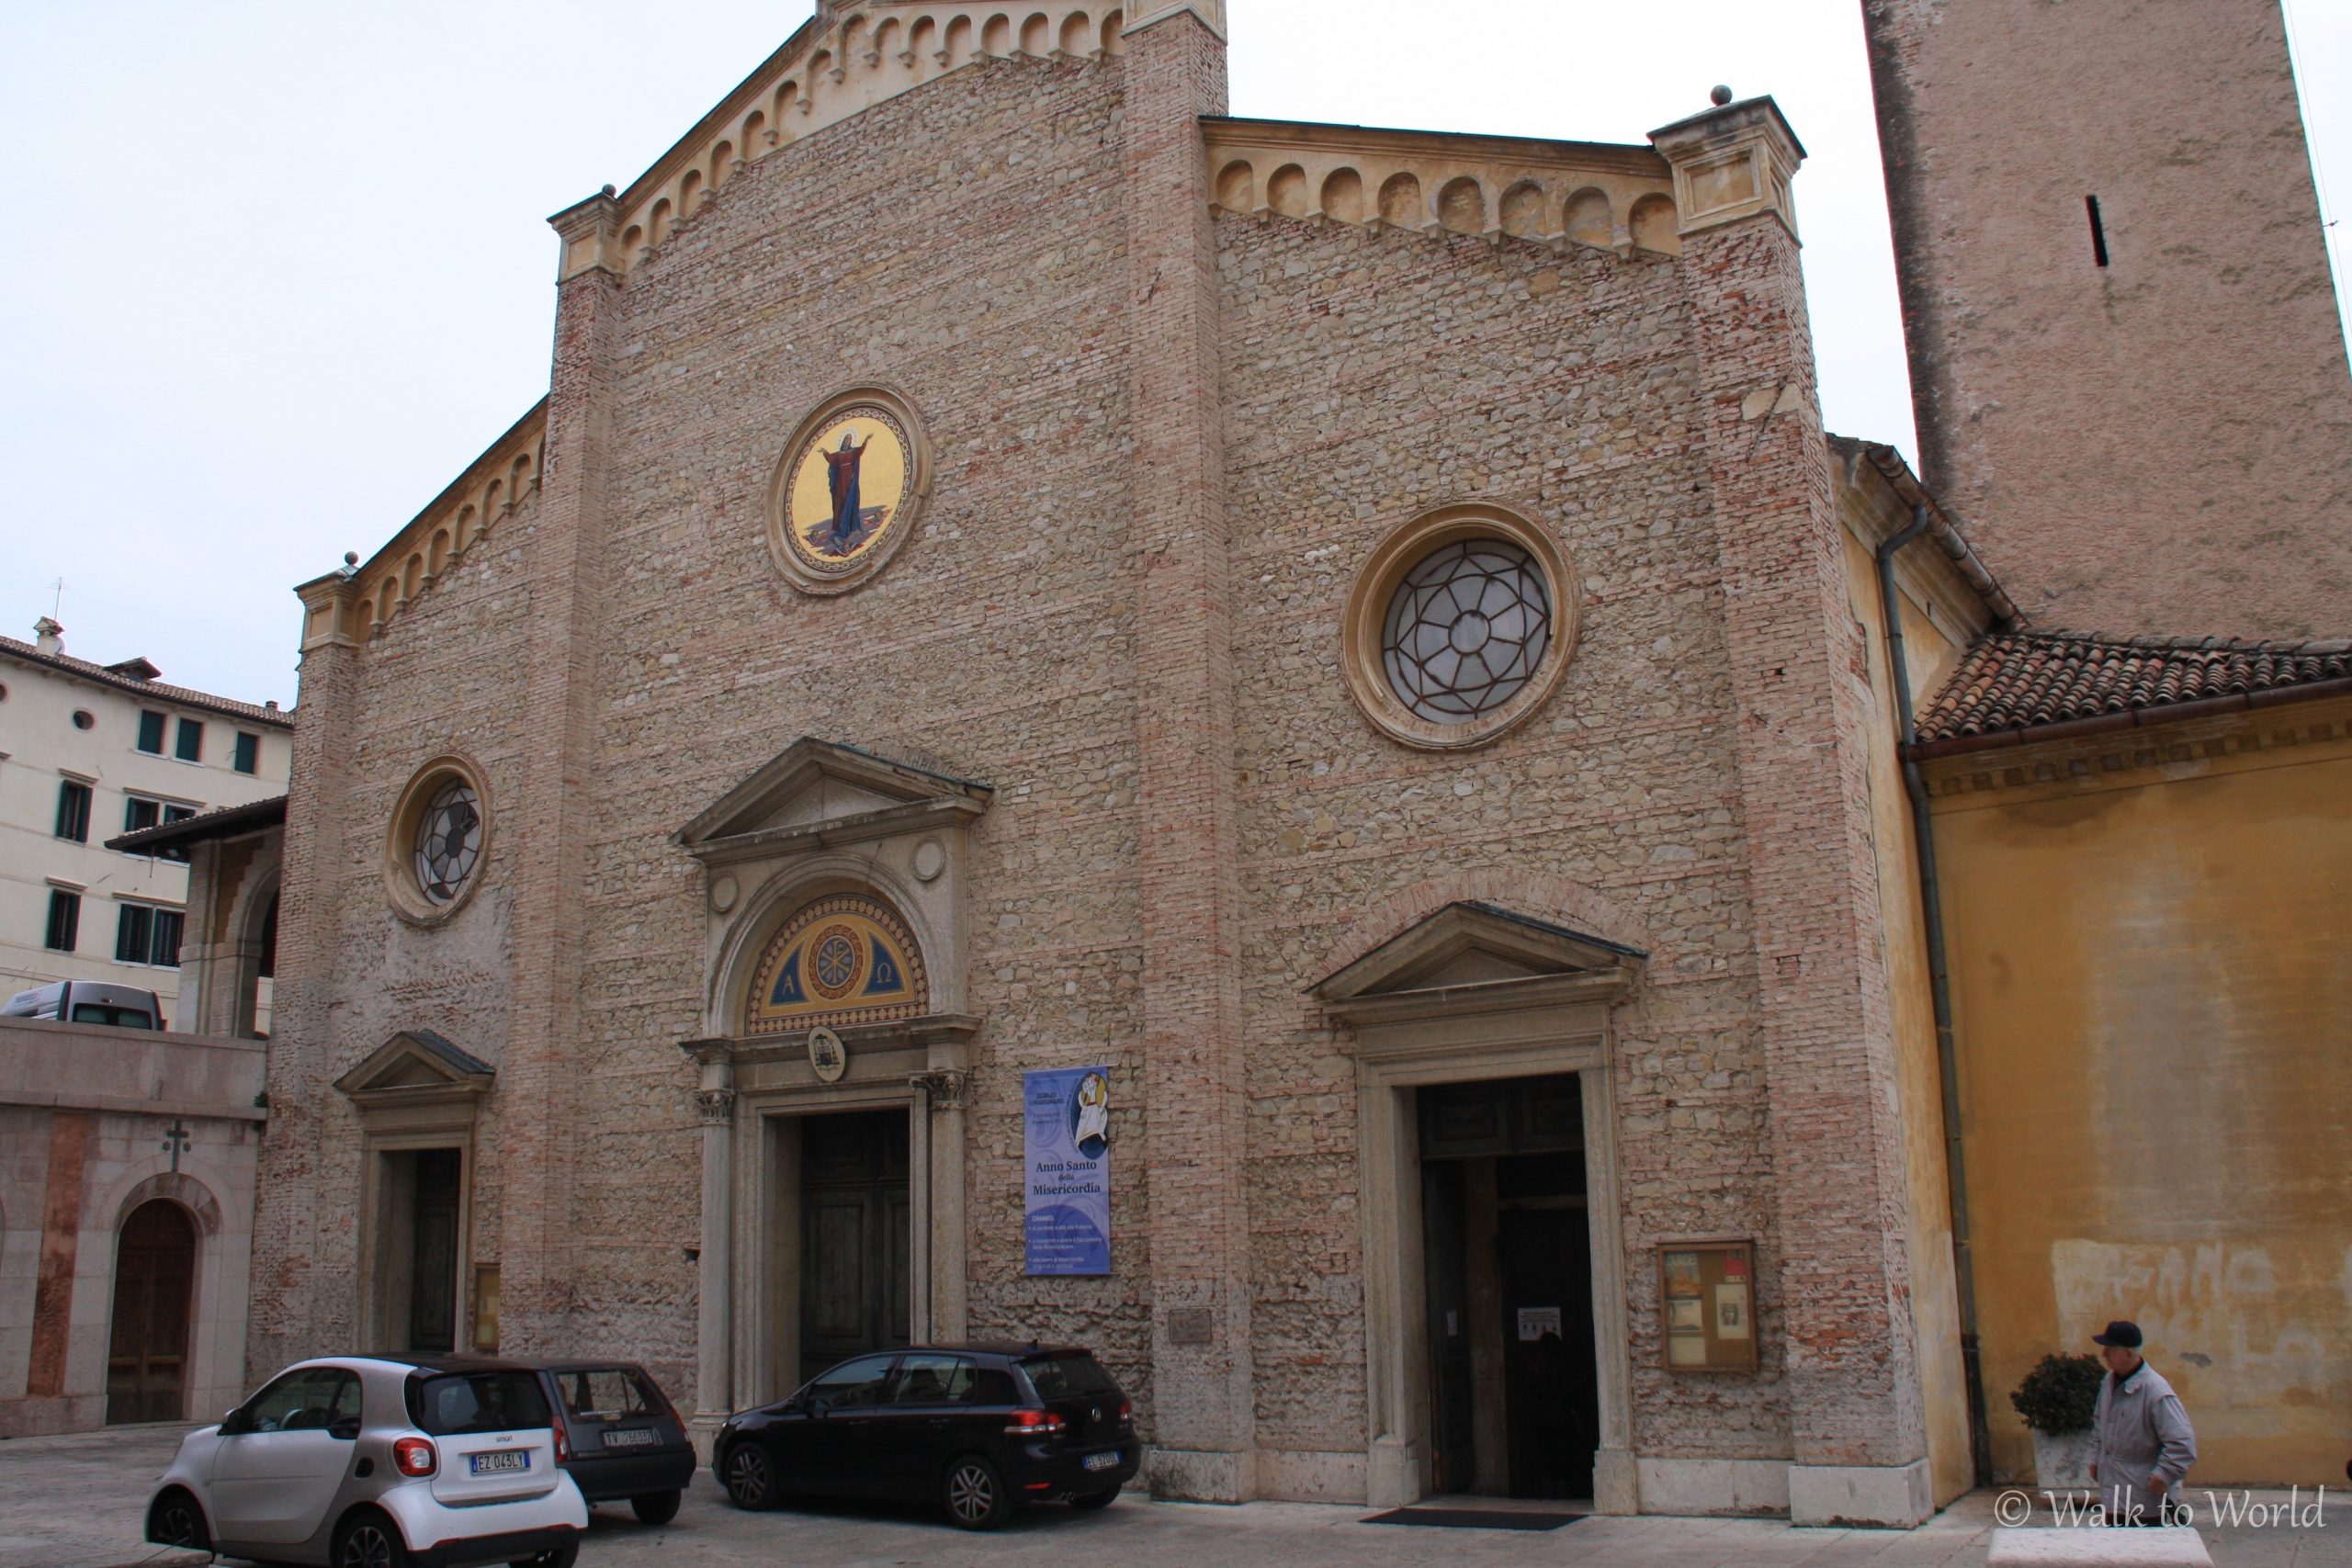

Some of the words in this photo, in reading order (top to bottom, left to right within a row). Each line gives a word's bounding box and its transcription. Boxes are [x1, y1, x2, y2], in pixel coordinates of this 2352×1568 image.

[1036, 1162, 1064, 1172] Anno
[1066, 1161, 1097, 1171] Santo
[1058, 1173, 1074, 1181] della
[1033, 1182, 1101, 1195] Misericordia
[606, 1432, 618, 1444] TV
[478, 1455, 492, 1470] EZ
[493, 1452, 524, 1469] 043LY
